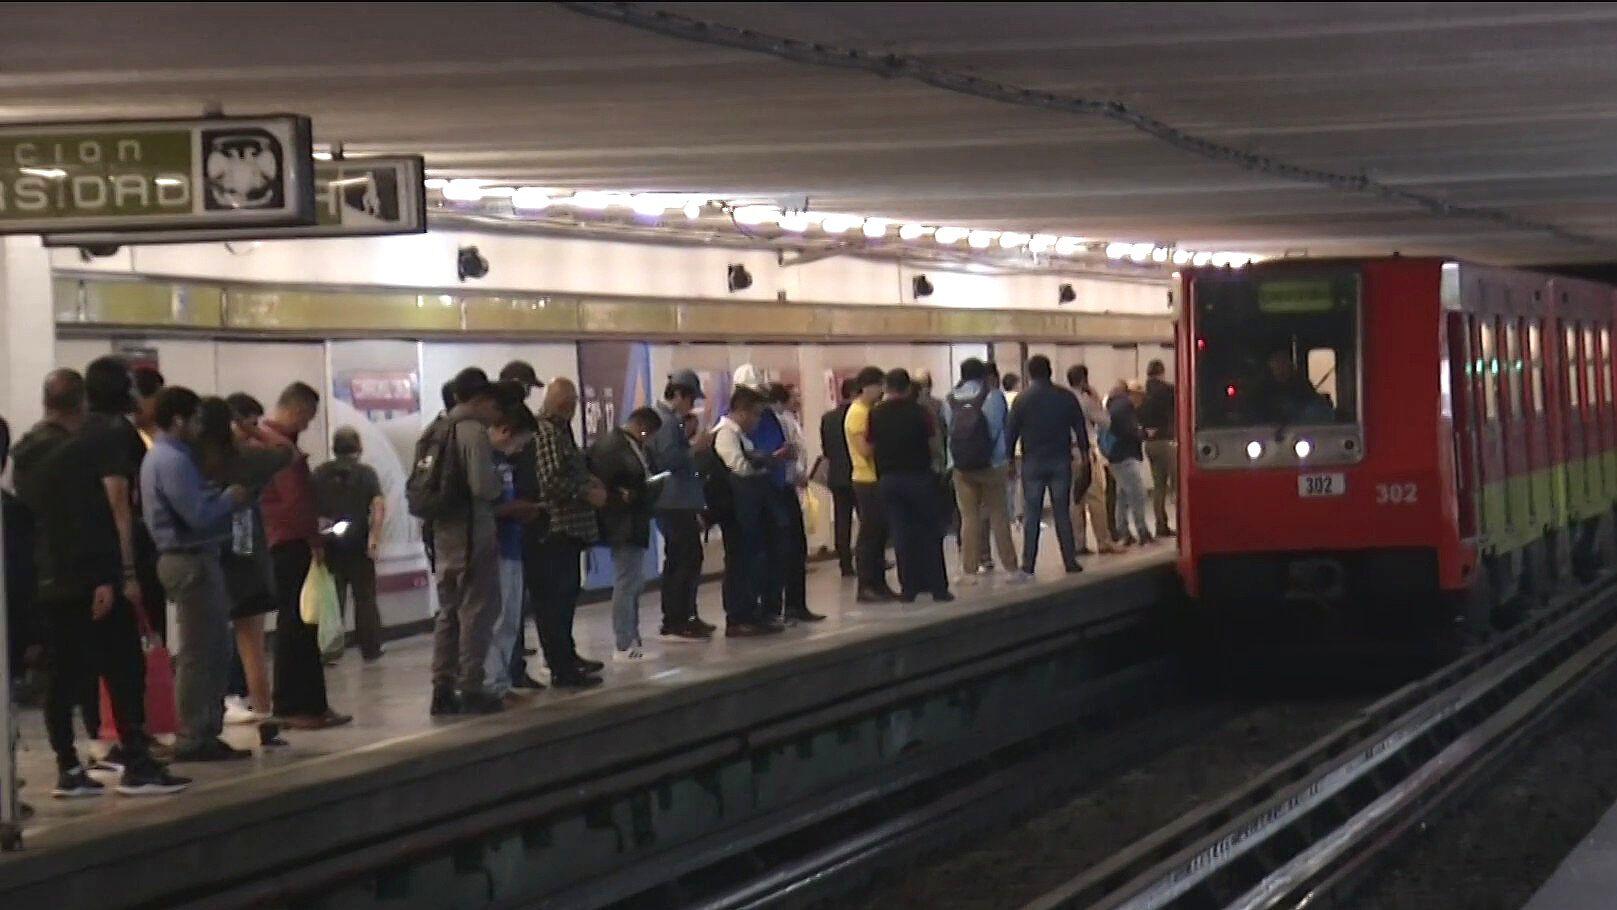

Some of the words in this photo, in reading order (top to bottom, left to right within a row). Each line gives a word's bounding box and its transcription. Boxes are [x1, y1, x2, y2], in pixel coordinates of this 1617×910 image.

[0, 173, 191, 210] SIDAD
[1305, 476, 1333, 494] 302
[1375, 482, 1419, 503] 302
